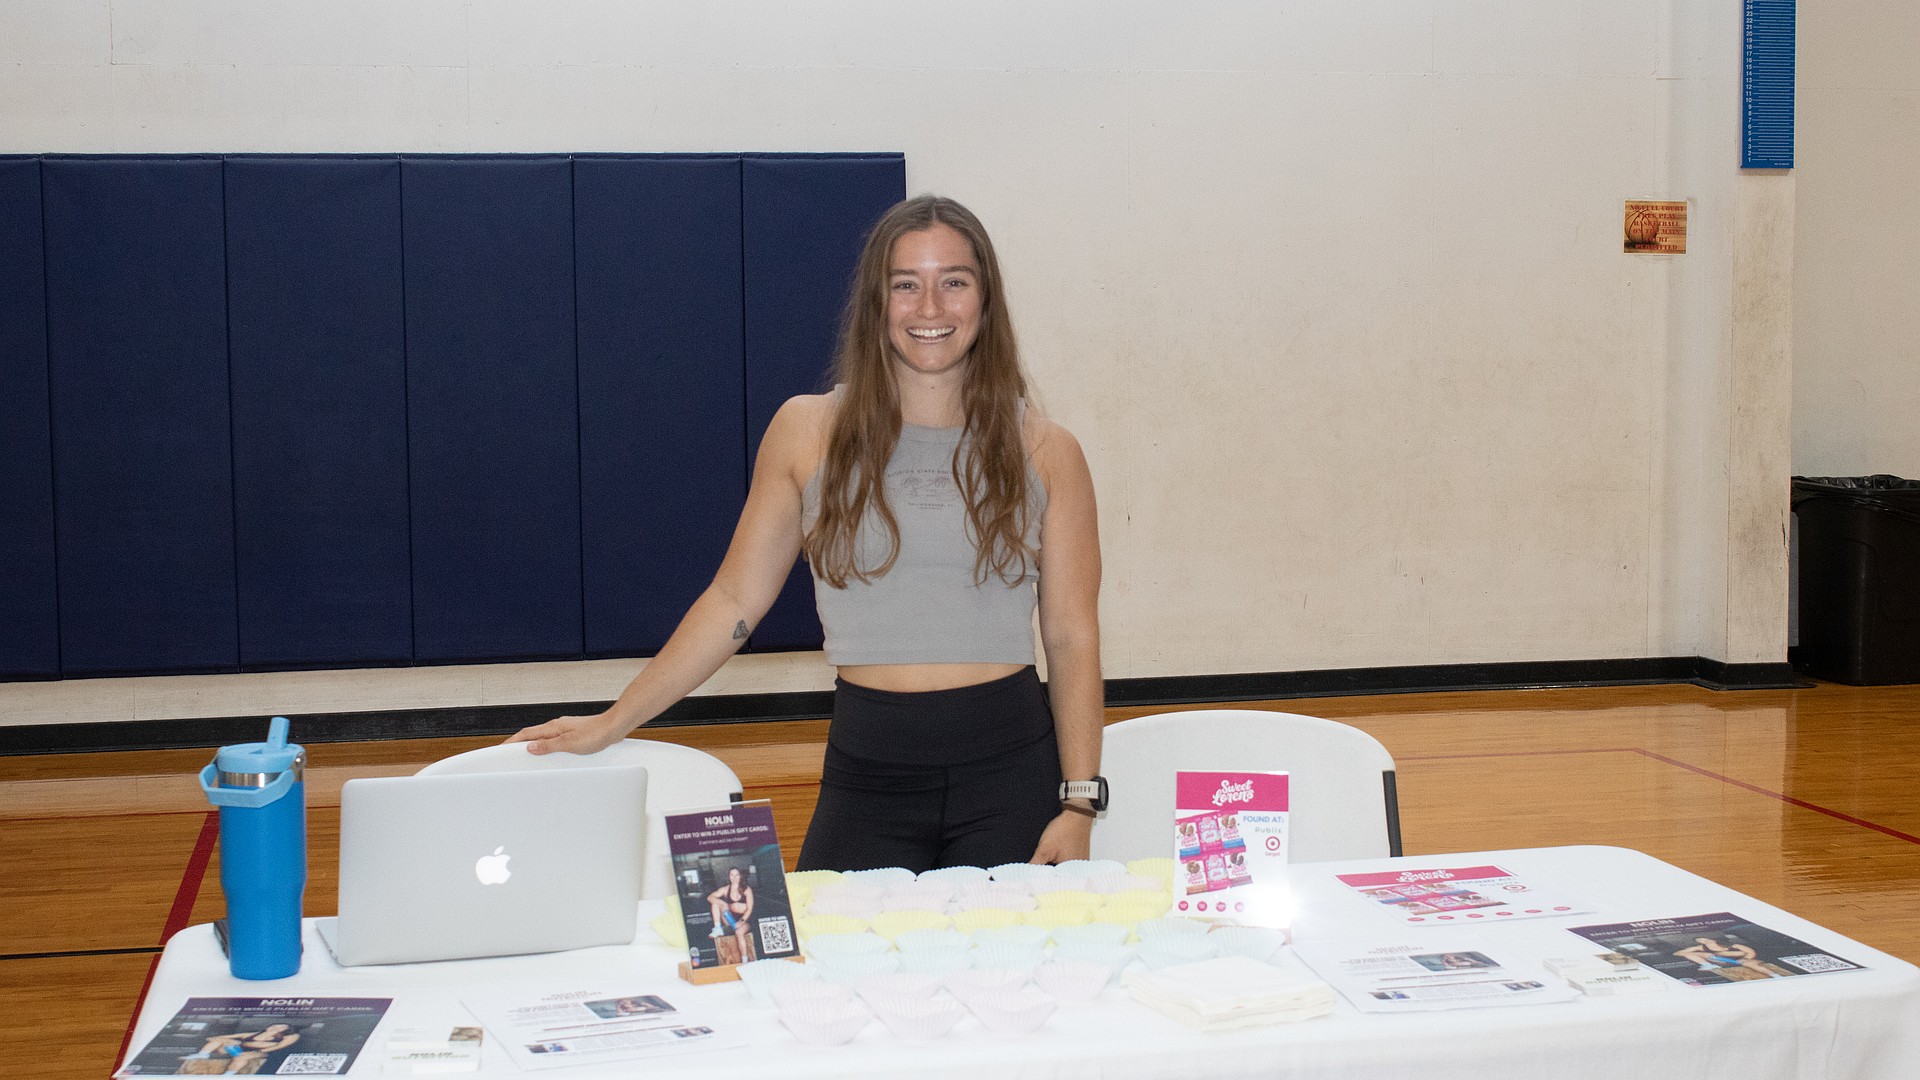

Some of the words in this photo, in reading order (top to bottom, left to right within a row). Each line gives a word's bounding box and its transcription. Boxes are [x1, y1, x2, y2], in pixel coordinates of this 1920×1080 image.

[1220, 779, 1253, 794] Sweet
[704, 815, 734, 826] NOLIN
[1630, 920, 1676, 928] NOLIN
